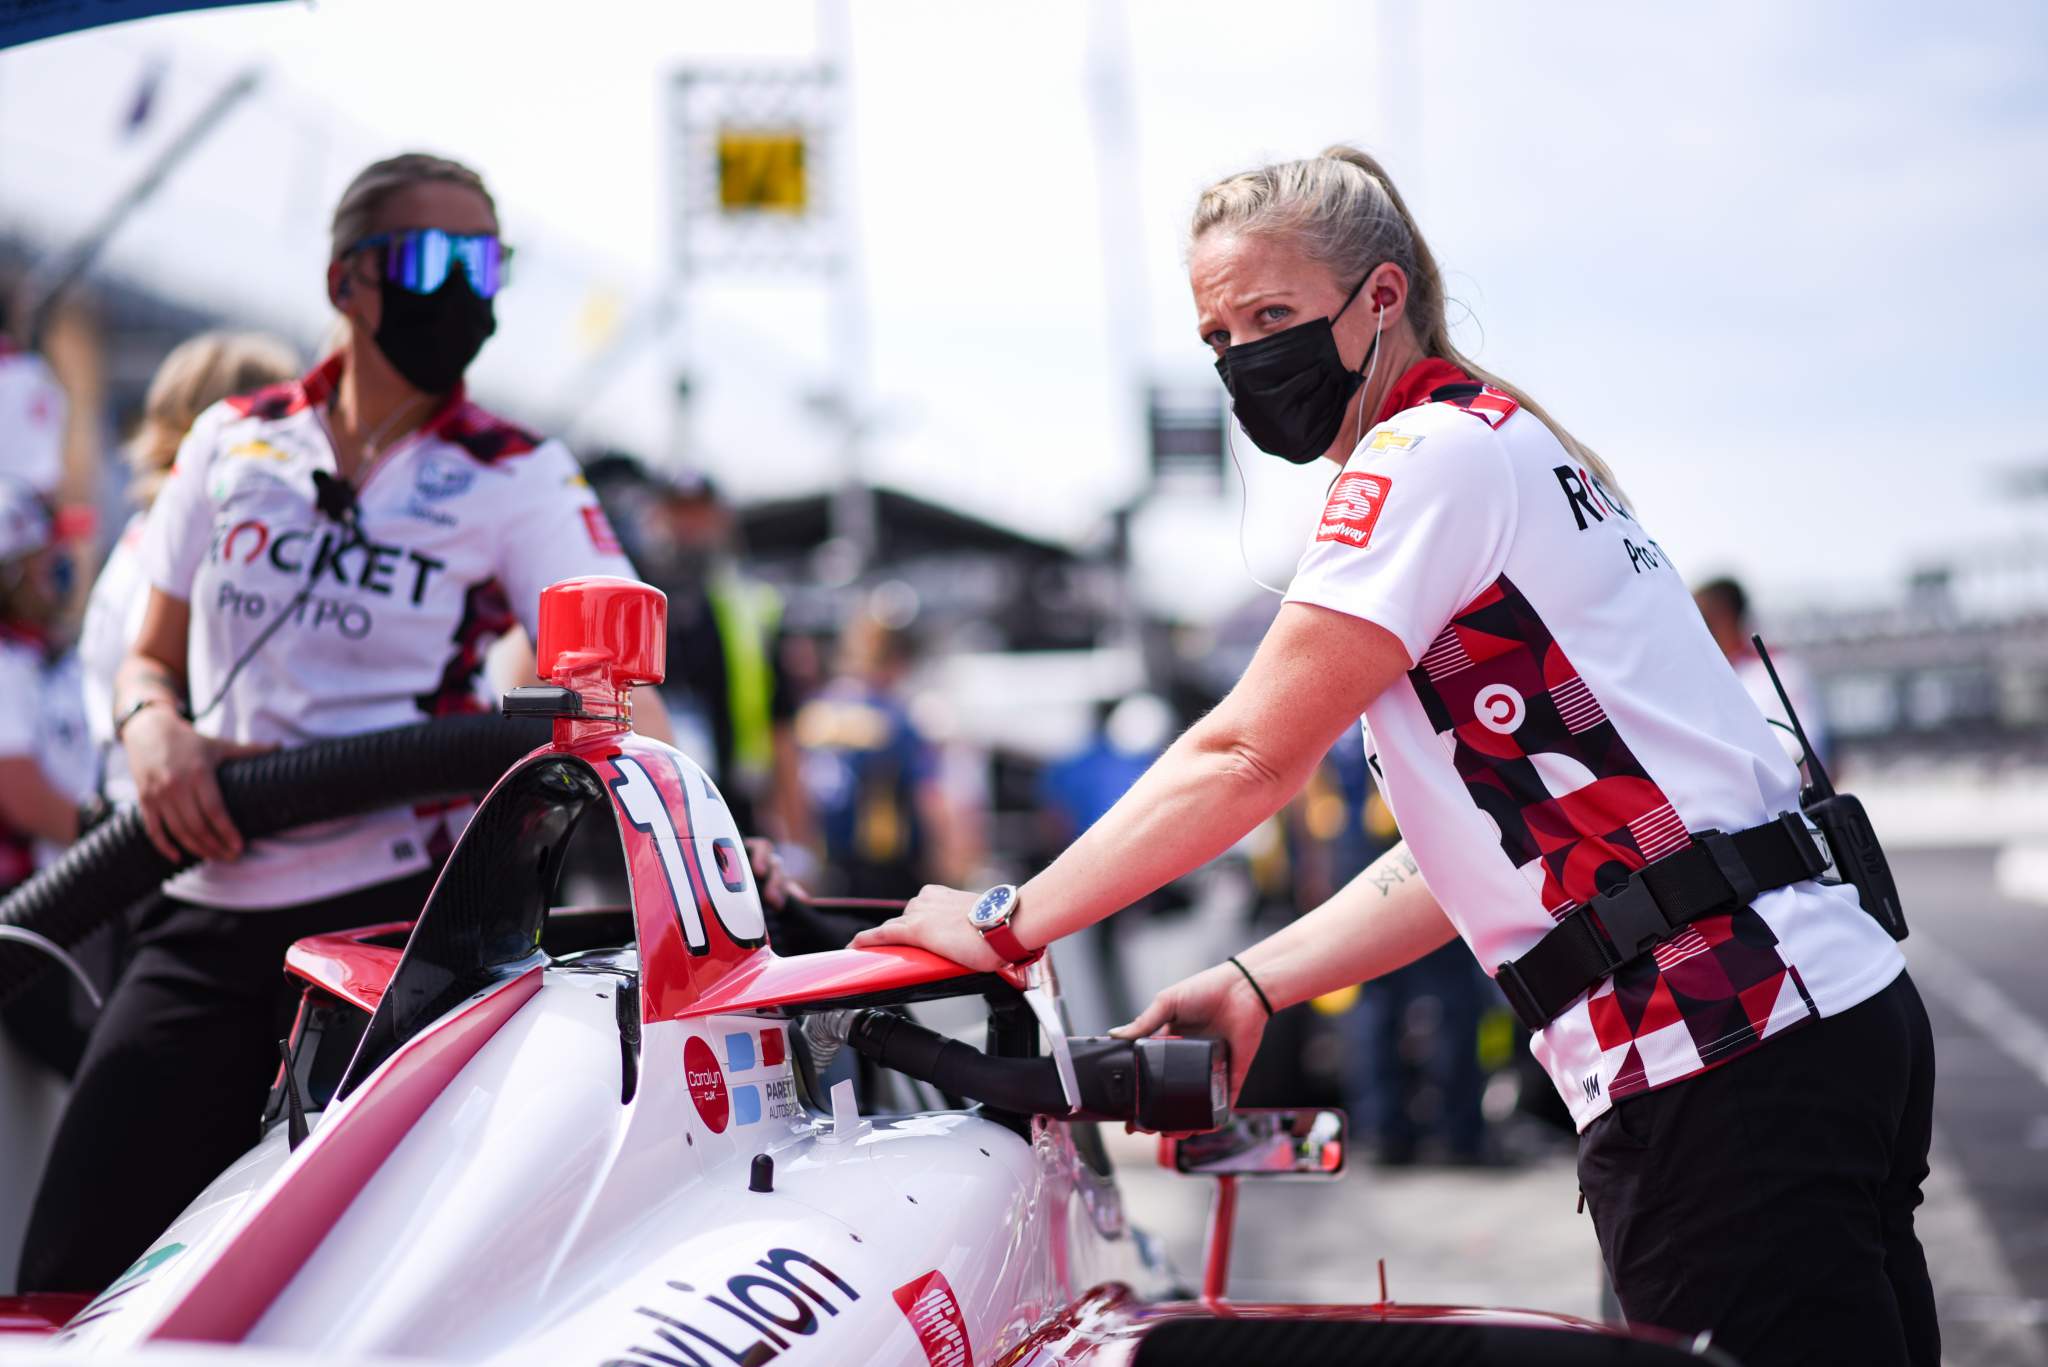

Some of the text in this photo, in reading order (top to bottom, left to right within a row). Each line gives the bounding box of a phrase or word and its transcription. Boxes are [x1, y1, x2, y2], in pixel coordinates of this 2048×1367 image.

[212, 516, 445, 607] OCKET
[218, 580, 267, 619] Pro
[608, 754, 768, 957] 16
